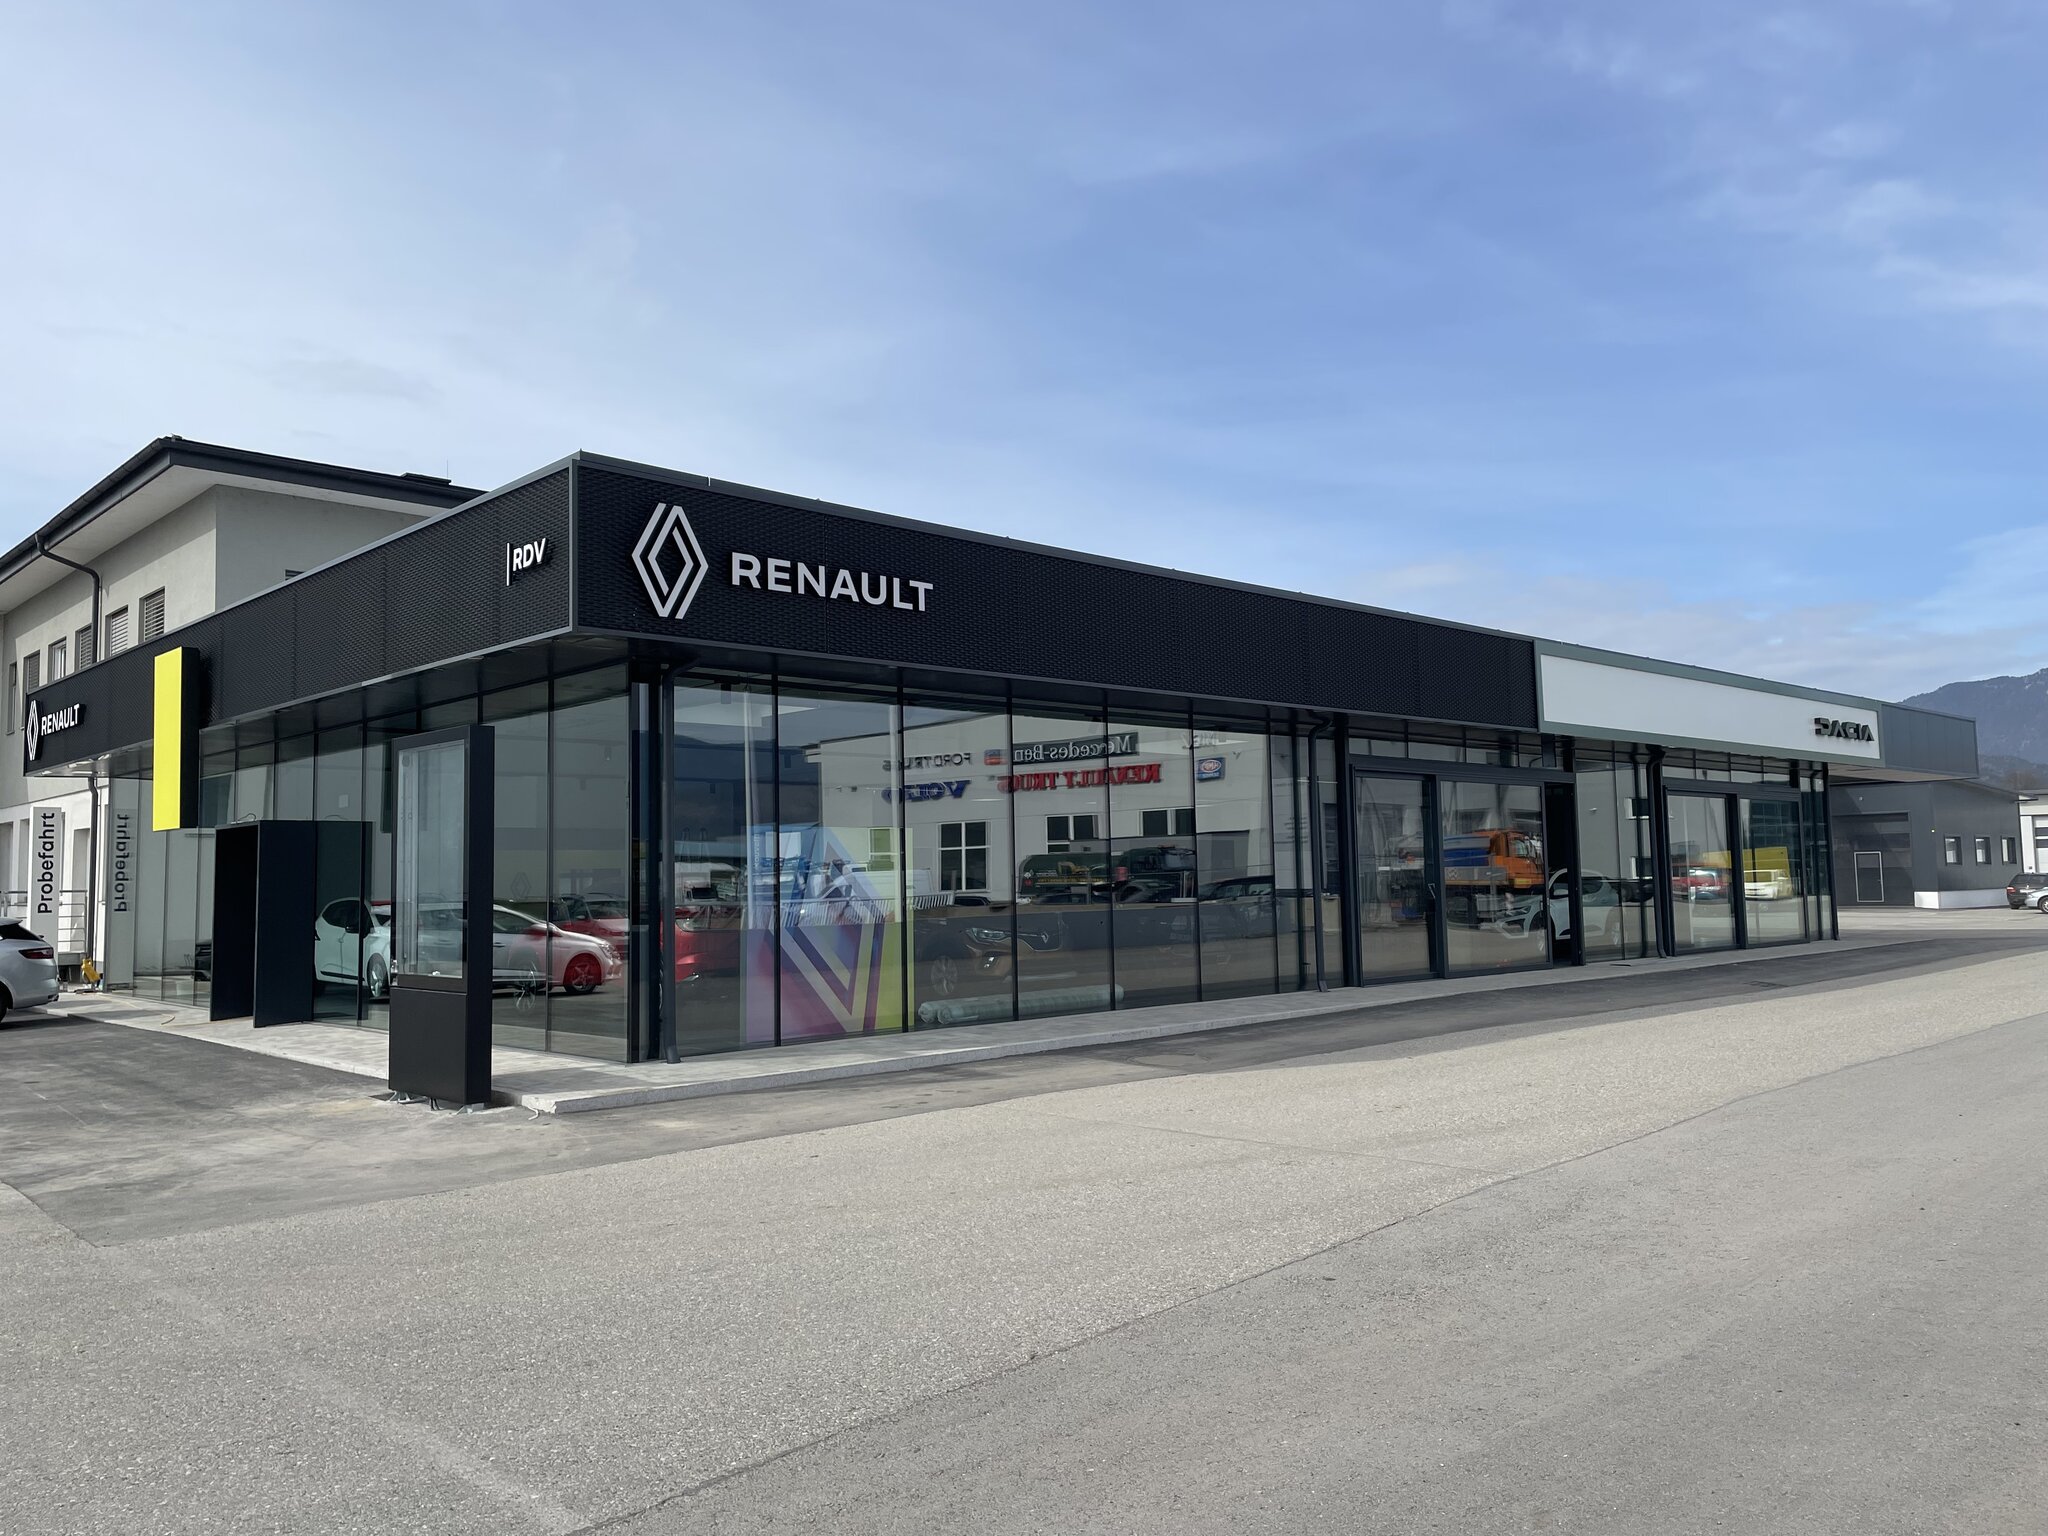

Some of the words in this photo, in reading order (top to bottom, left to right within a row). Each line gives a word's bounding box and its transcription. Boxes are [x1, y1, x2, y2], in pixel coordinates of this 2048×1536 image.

[512, 538, 546, 572] RDV
[731, 551, 934, 611] RENAULT
[41, 704, 80, 736] RENAULT
[1814, 717, 1875, 742] DACIA
[37, 812, 55, 914] Probefahrt
